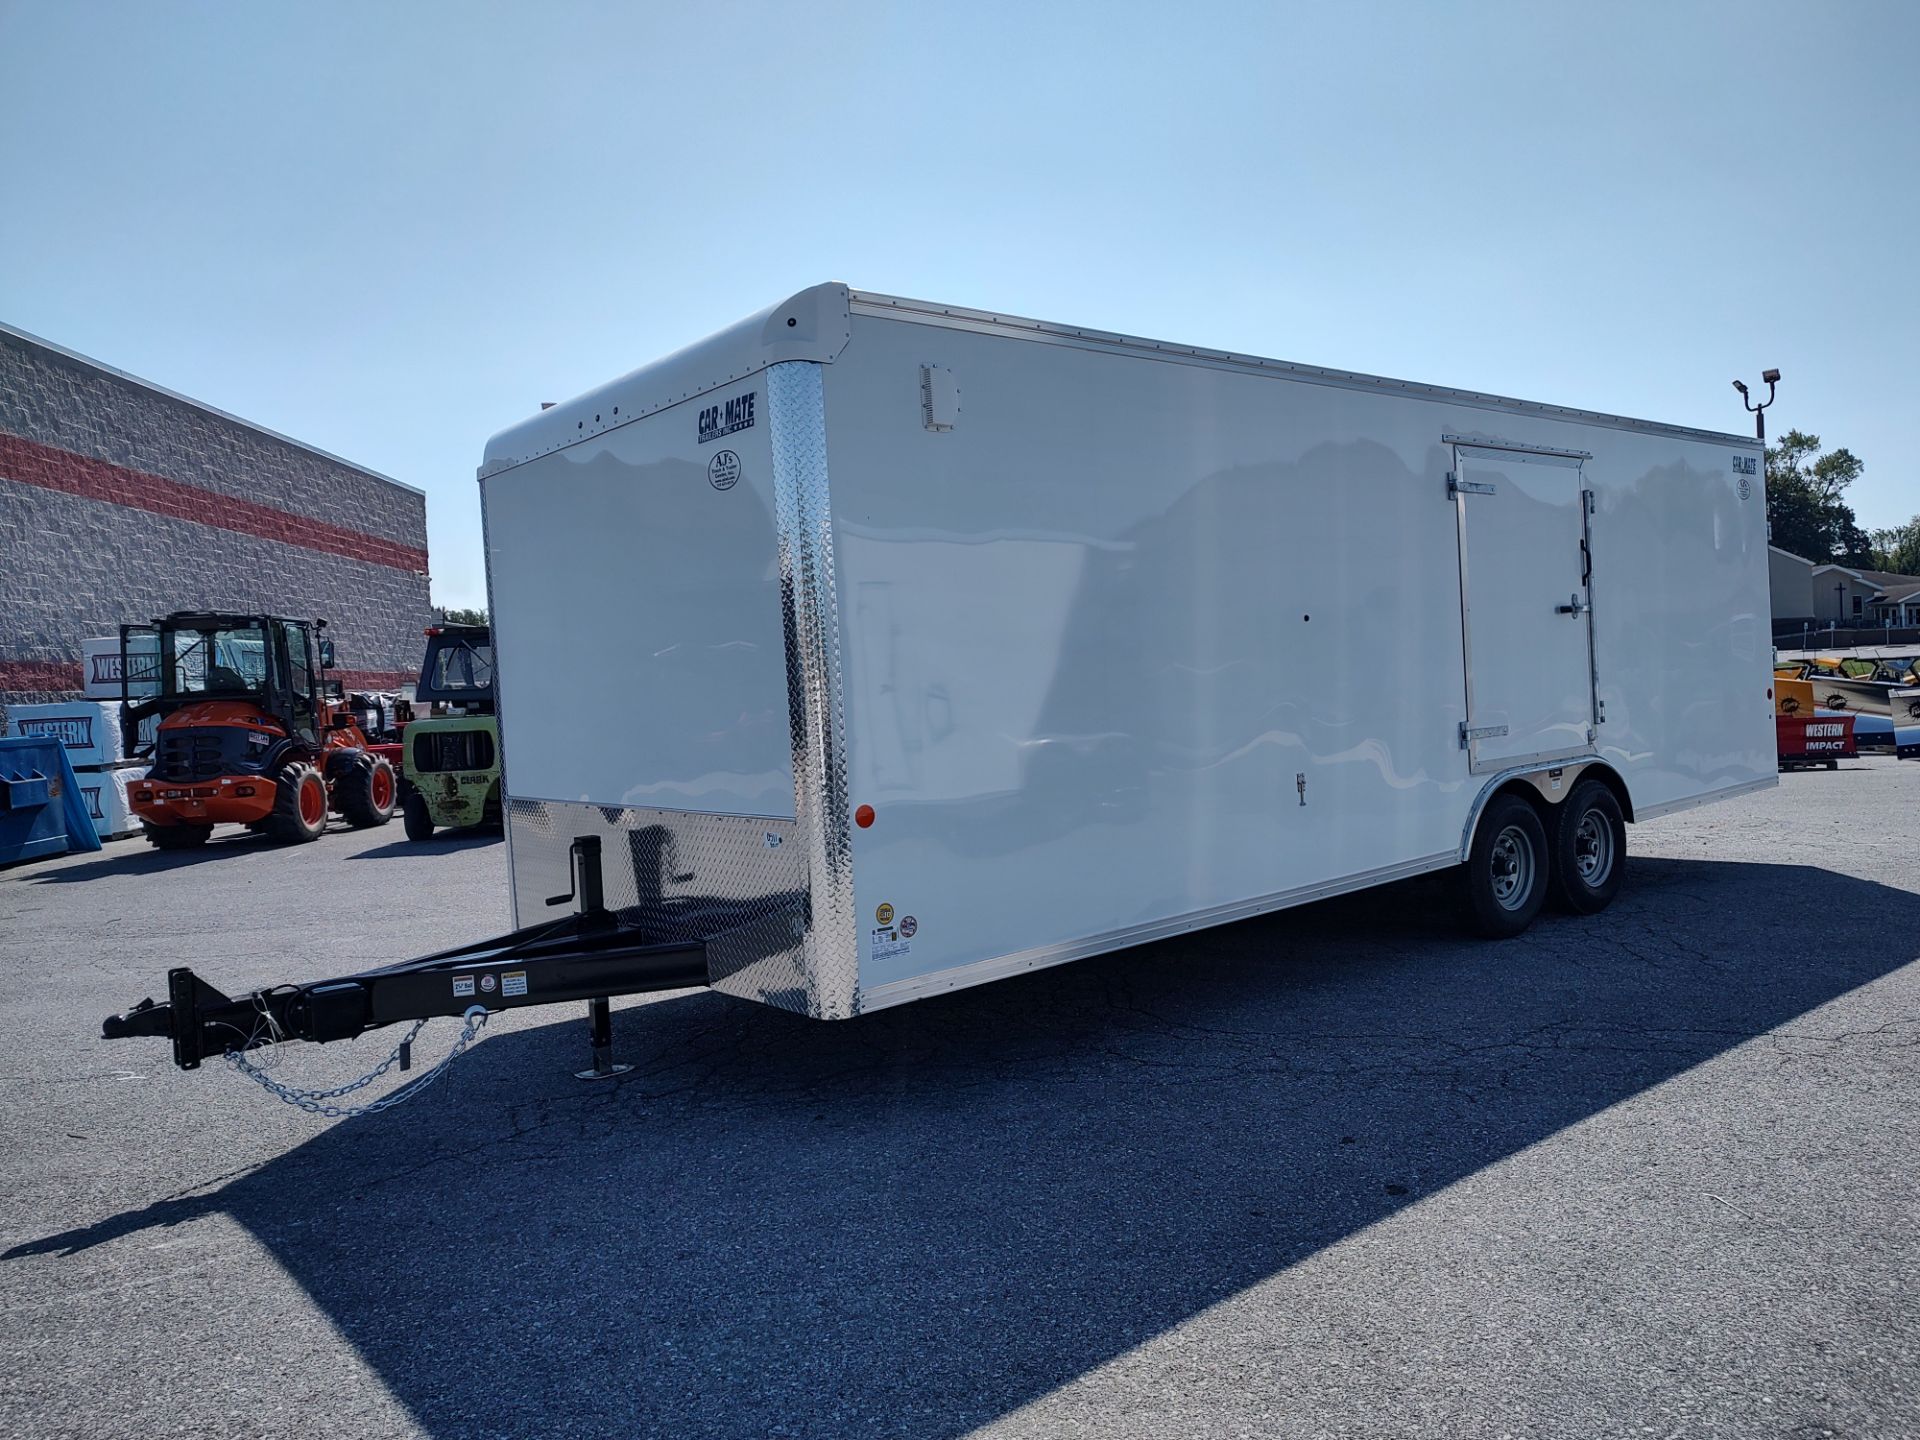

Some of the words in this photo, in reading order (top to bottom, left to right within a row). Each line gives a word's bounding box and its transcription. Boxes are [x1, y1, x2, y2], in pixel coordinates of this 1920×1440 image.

[698, 405, 718, 435] CAR
[725, 392, 755, 425] MATE
[96, 656, 157, 679] WESTERN
[22, 721, 89, 744] WESTERN
[1805, 723, 1845, 737] WESTERN
[1805, 741, 1845, 751] IMPACT
